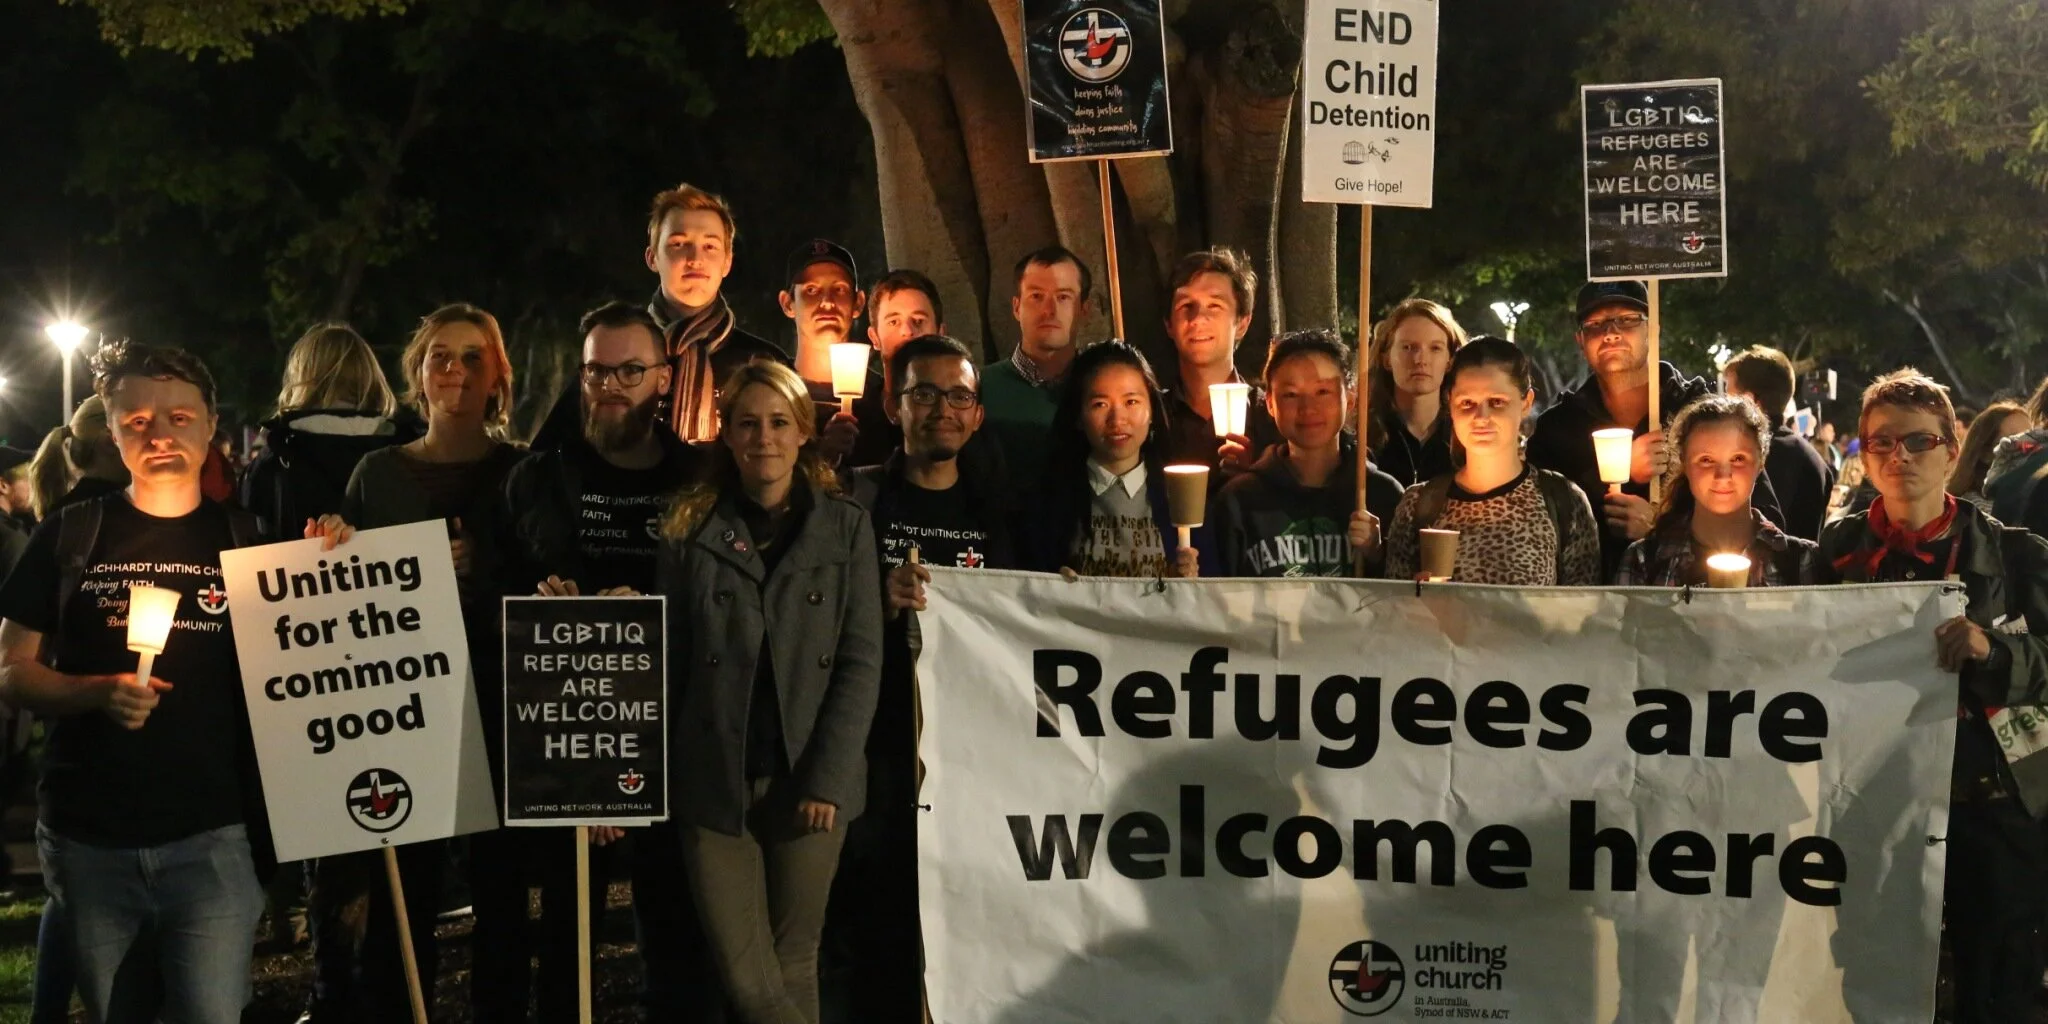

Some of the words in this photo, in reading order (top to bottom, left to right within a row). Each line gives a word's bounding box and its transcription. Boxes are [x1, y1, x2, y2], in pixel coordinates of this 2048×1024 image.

[1335, 8, 1412, 46] END
[1325, 59, 1418, 98] Child
[1074, 88, 1103, 100] keeping
[1104, 85, 1123, 97] faith
[1075, 106, 1095, 117] doing
[1096, 103, 1123, 118] justice
[1310, 101, 1430, 131] Detention
[1609, 106, 1707, 127] LGBTIQ
[1098, 119, 1138, 134] community
[1601, 132, 1709, 151] REFUGEES
[1633, 154, 1678, 171] ARE
[1335, 178, 1364, 192] Give
[1367, 180, 1403, 196] Hope!
[1596, 173, 1717, 194] WELCOME
[1620, 201, 1700, 226] HERE
[611, 496, 650, 505] UNITING
[582, 509, 611, 522] FAITH
[587, 528, 629, 539] JUSTICE
[921, 528, 960, 539] UNITING
[154, 563, 202, 575] UNITING
[256, 555, 422, 603] Uniting
[97, 596, 128, 612] Doing
[274, 614, 339, 651] for
[347, 602, 421, 640] the
[534, 622, 646, 645] LGBTIQ
[523, 654, 651, 672] REFUGEES
[264, 651, 451, 702] common
[561, 677, 614, 697] ARE
[516, 701, 659, 722] WELCOME
[1033, 647, 1591, 767] Refugees
[1625, 688, 1829, 763] are
[307, 692, 426, 755] good
[544, 732, 640, 760] HERE
[525, 804, 558, 812] UNITING
[606, 802, 652, 810] AUSTRALIA
[1005, 785, 1532, 889] welcome
[1568, 800, 1848, 908] here
[1414, 941, 1508, 971] uniting
[1414, 966, 1503, 990] church
[1414, 996, 1425, 1006] in
[1427, 996, 1471, 1007] Australia,
[1414, 1007, 1445, 1019] Synod
[1446, 1007, 1455, 1017] of
[1456, 1008, 1481, 1019] NSW
[1481, 1009, 1489, 1019] &
[1490, 1009, 1511, 1020] ACT
